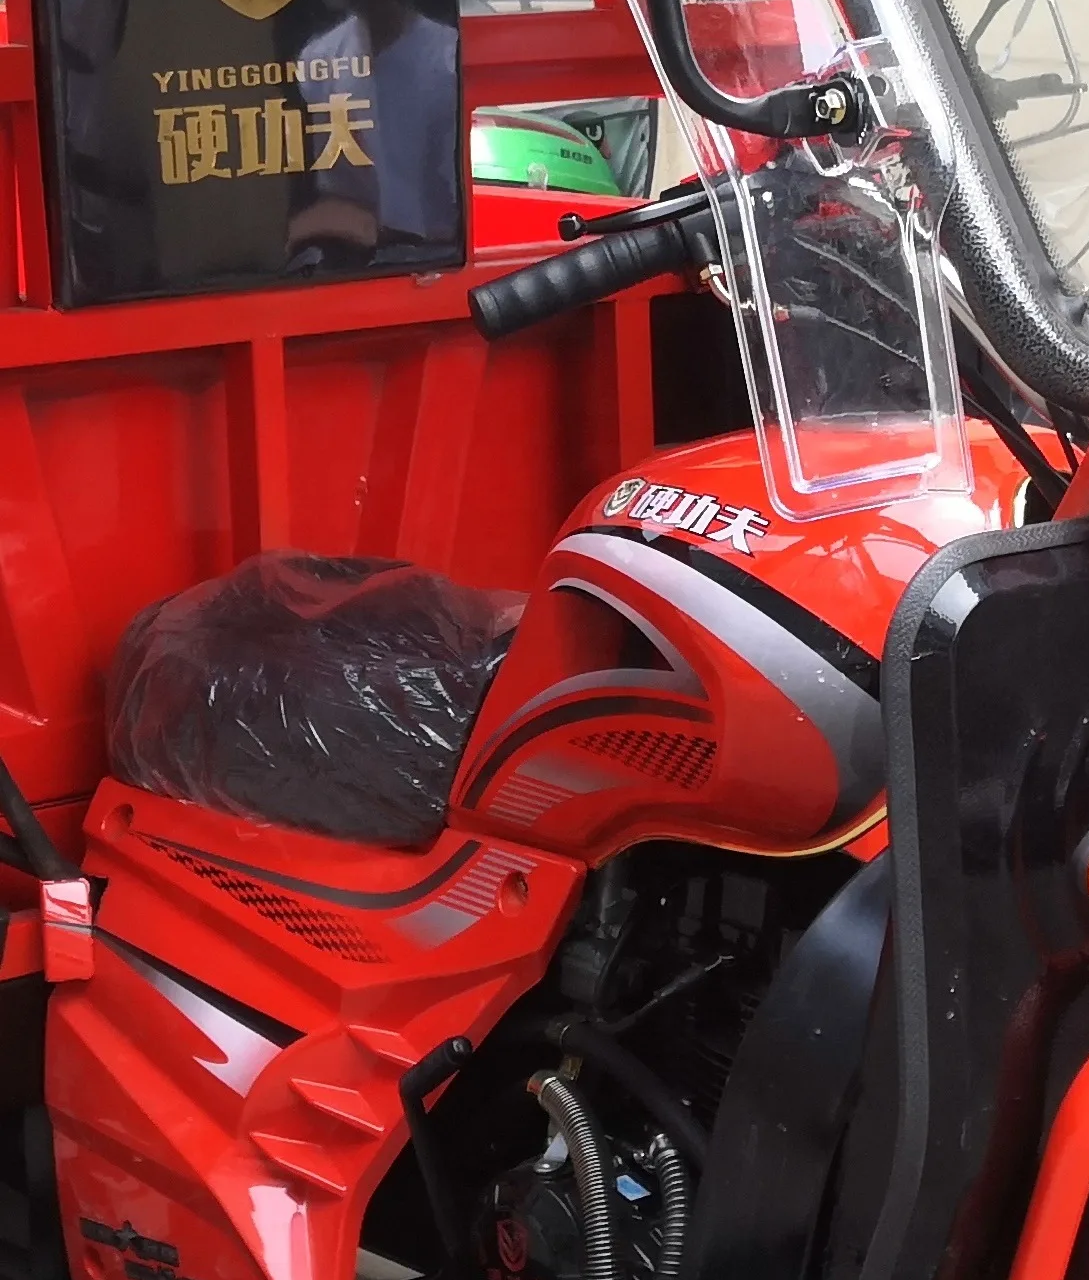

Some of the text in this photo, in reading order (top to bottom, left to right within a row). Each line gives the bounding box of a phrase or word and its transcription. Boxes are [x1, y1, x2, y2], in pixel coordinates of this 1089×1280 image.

[152, 55, 371, 93] YINGGONGFU
[153, 92, 375, 185] 硬功夫
[628, 482, 771, 557] 硬功夫
